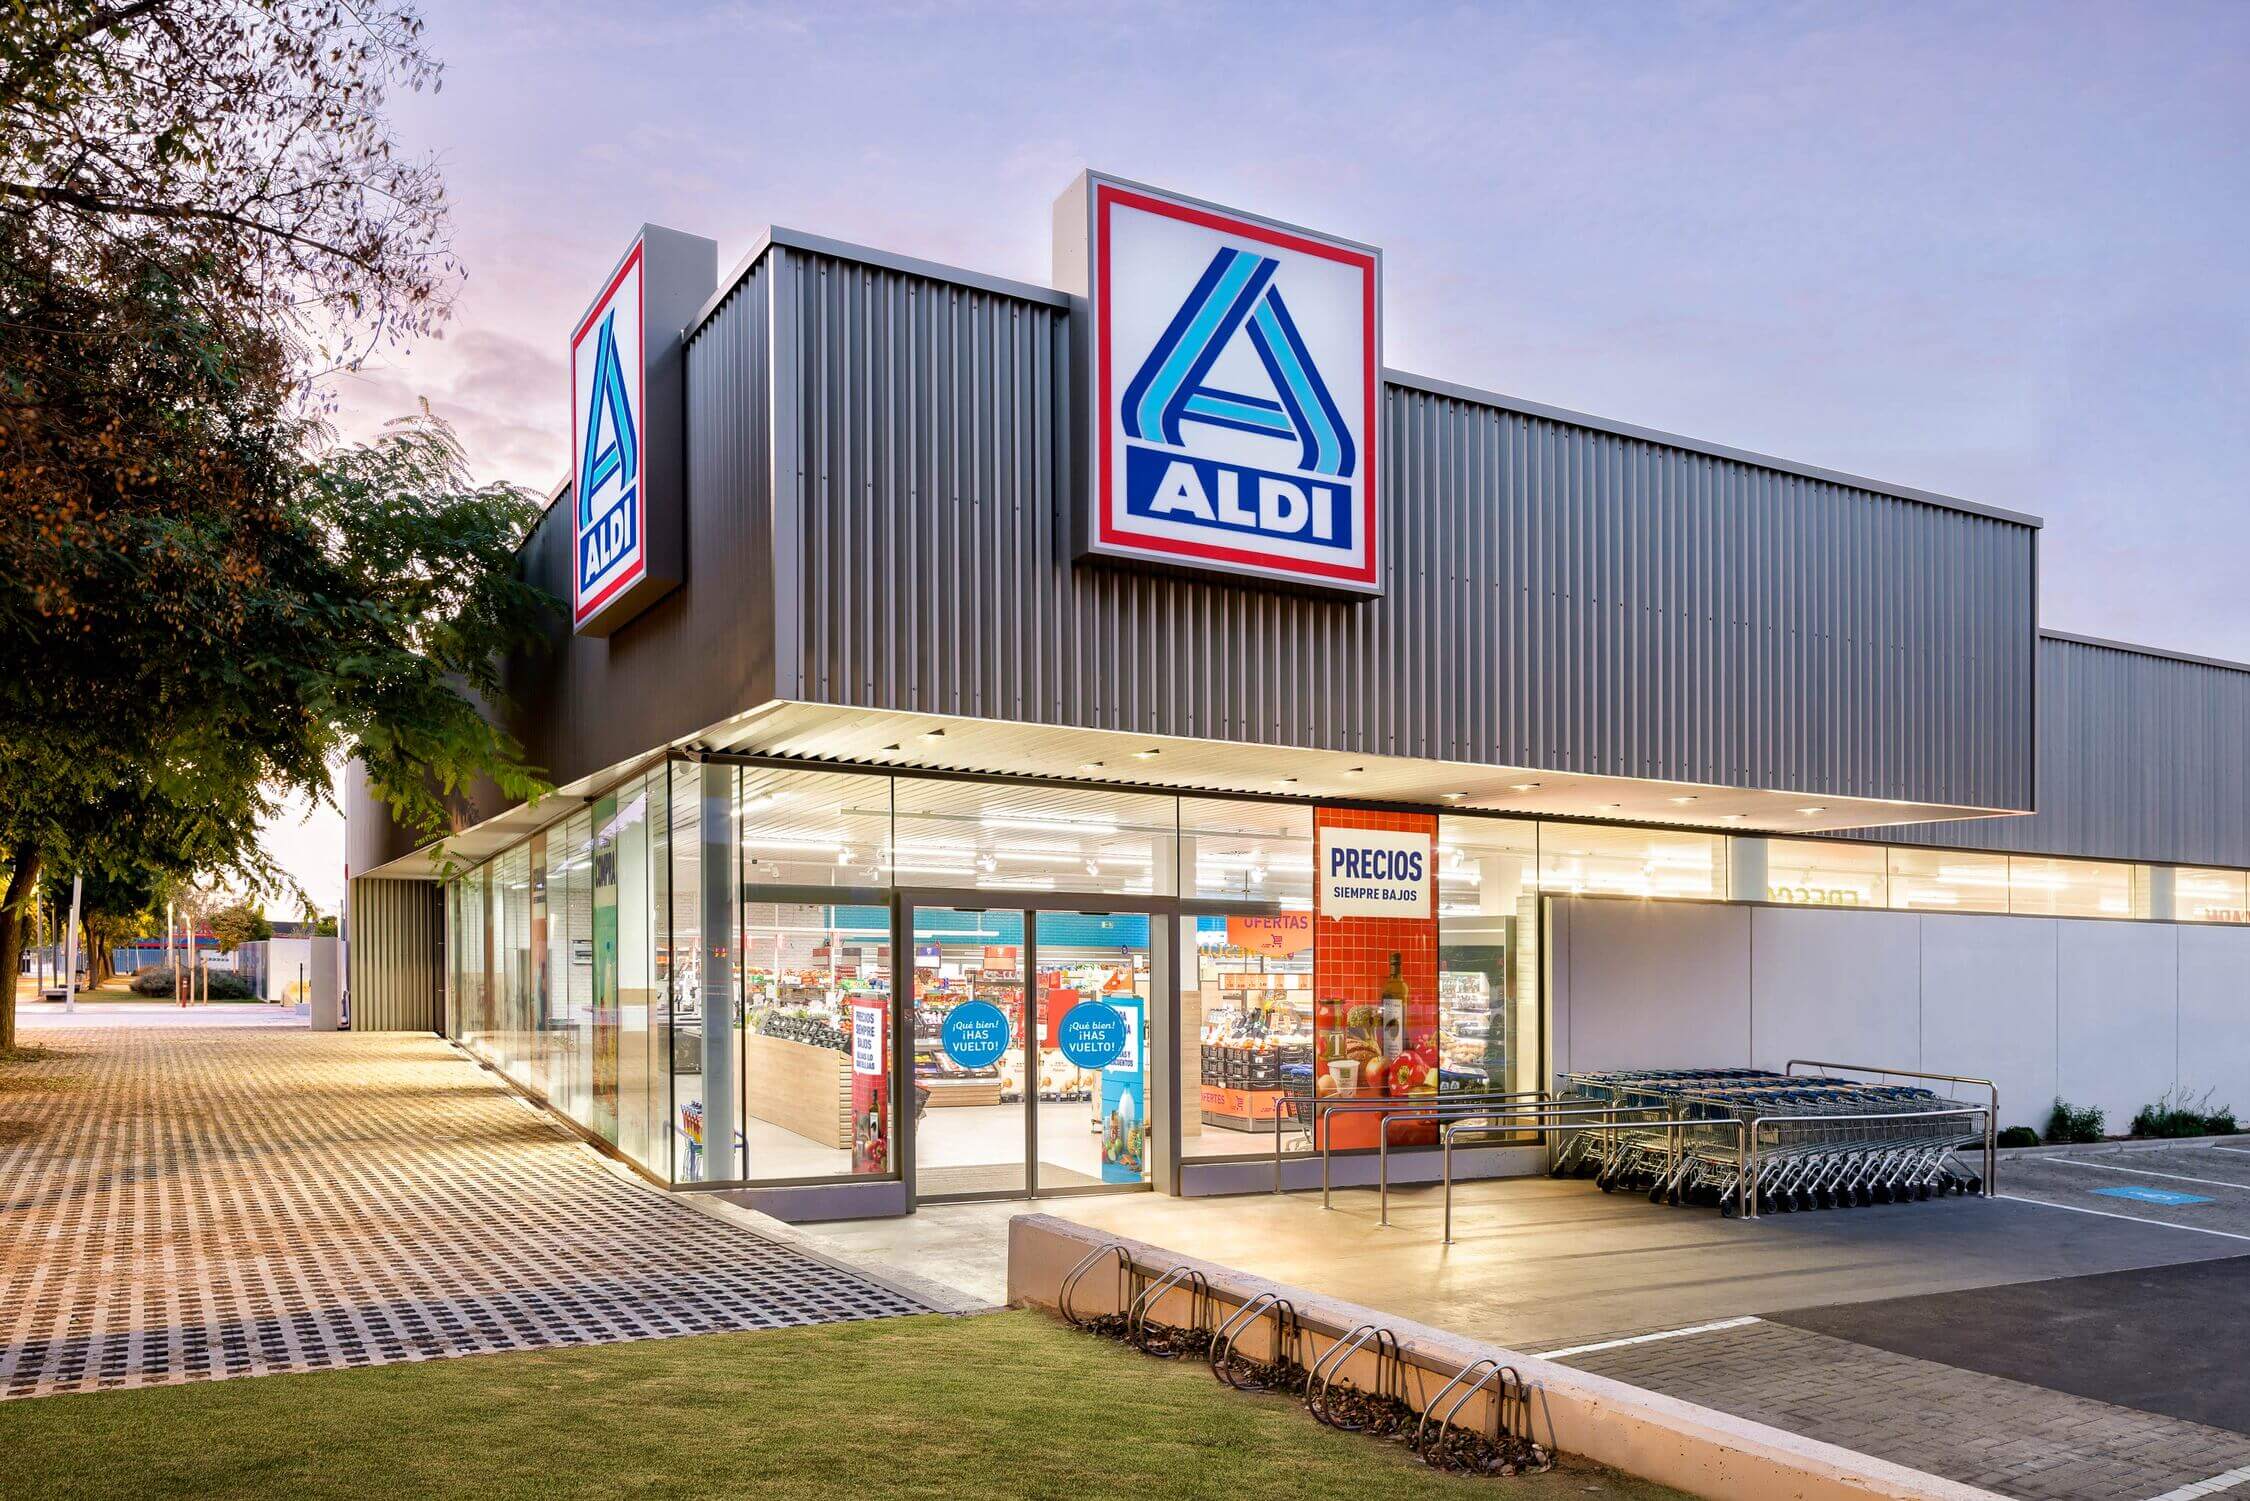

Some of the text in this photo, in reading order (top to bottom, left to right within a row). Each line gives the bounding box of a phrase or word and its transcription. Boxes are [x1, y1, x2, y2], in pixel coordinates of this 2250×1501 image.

[1149, 461, 1333, 540] ALDI
[585, 496, 631, 584] ALDI
[1331, 847, 1422, 881] PRECIOS
[1334, 887, 1417, 901] SIEMPRE BAJOS
[1244, 915, 1308, 930] OFERTAS
[953, 1020, 999, 1032] ¡Qué bien!
[1069, 1022, 1090, 1032] ¡Qué
[1092, 1021, 1115, 1030] bien!
[963, 1030, 989, 1040] ¡HAS
[1079, 1031, 1105, 1041] ¡HAS
[953, 1041, 999, 1052] VUELTO!
[1069, 1042, 1115, 1052] VUELTO!
